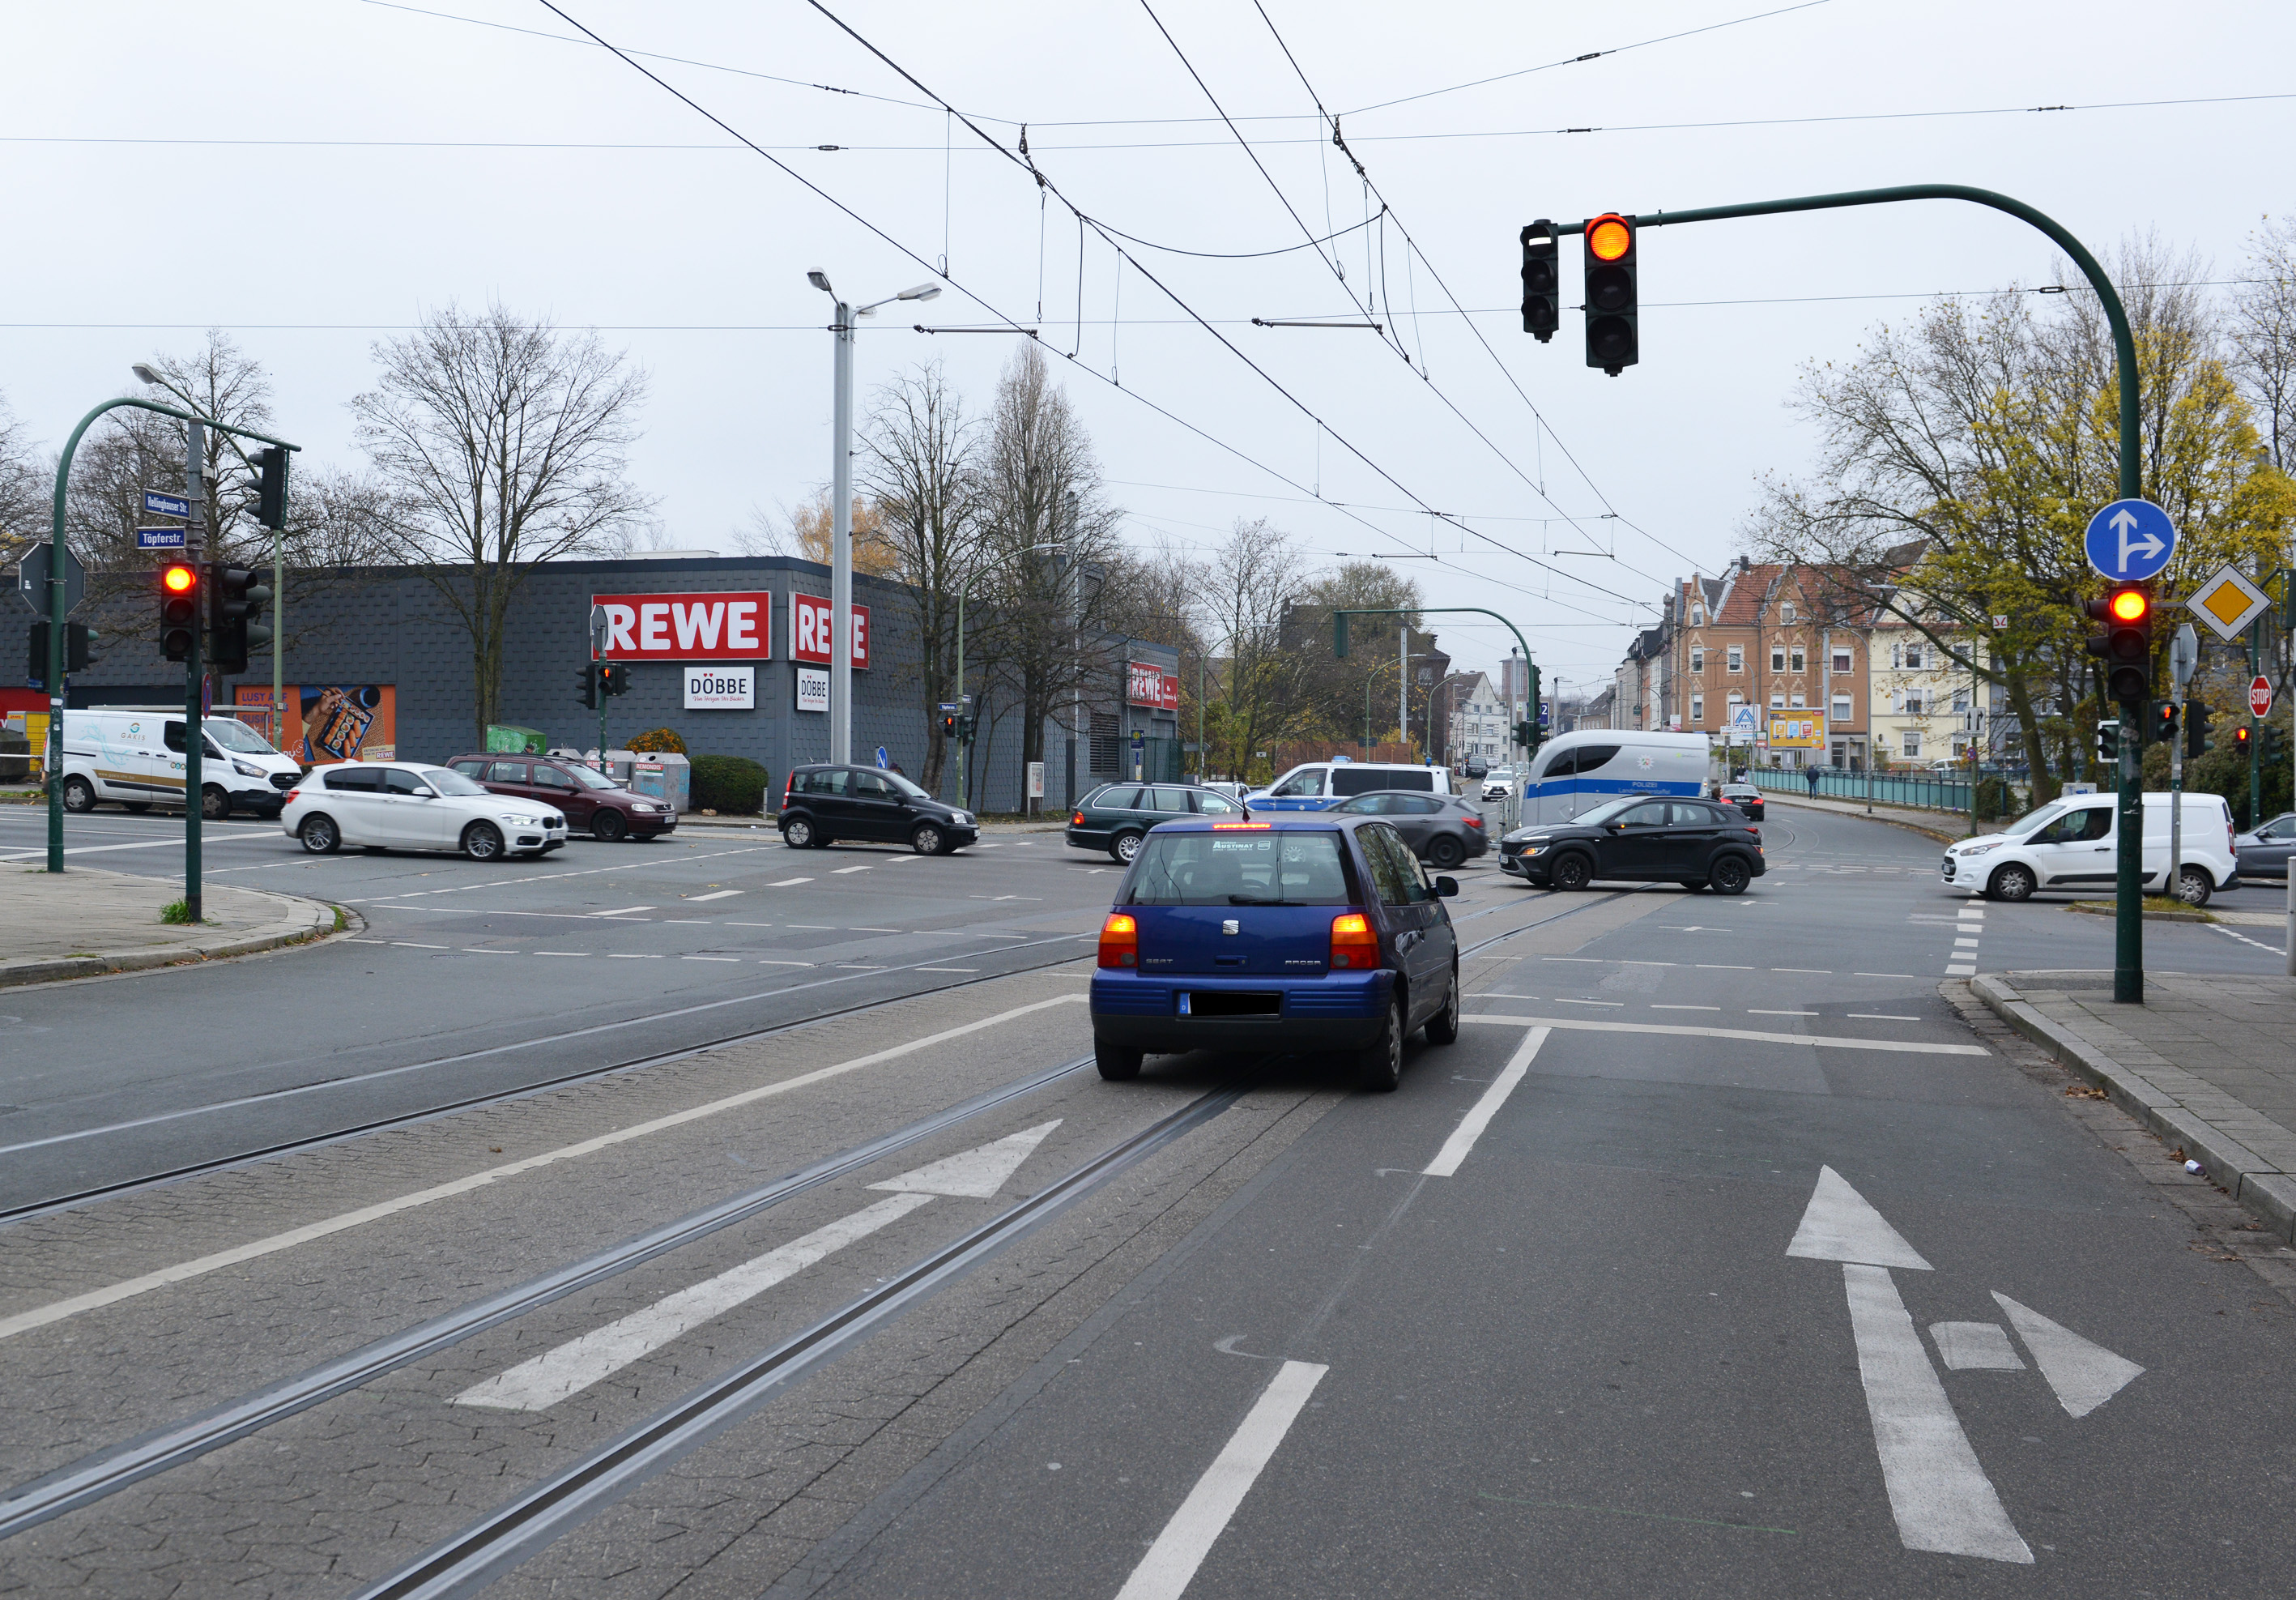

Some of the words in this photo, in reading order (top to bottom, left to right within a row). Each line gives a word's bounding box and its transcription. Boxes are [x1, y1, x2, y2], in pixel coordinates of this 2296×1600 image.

[147, 496, 179, 511] Rellinghauser
[179, 501, 188, 513] Str.
[143, 533, 183, 546] Töpferstr.
[603, 602, 759, 651] REWE
[799, 604, 865, 659] REE
[691, 673, 747, 694] DÖBBE
[802, 675, 826, 698] DÖBBE
[1132, 668, 1161, 702] REWE
[242, 693, 266, 702] LUST
[268, 693, 288, 702] AF
[2251, 689, 2269, 705] STOP
[121, 732, 146, 741] GAKIS
